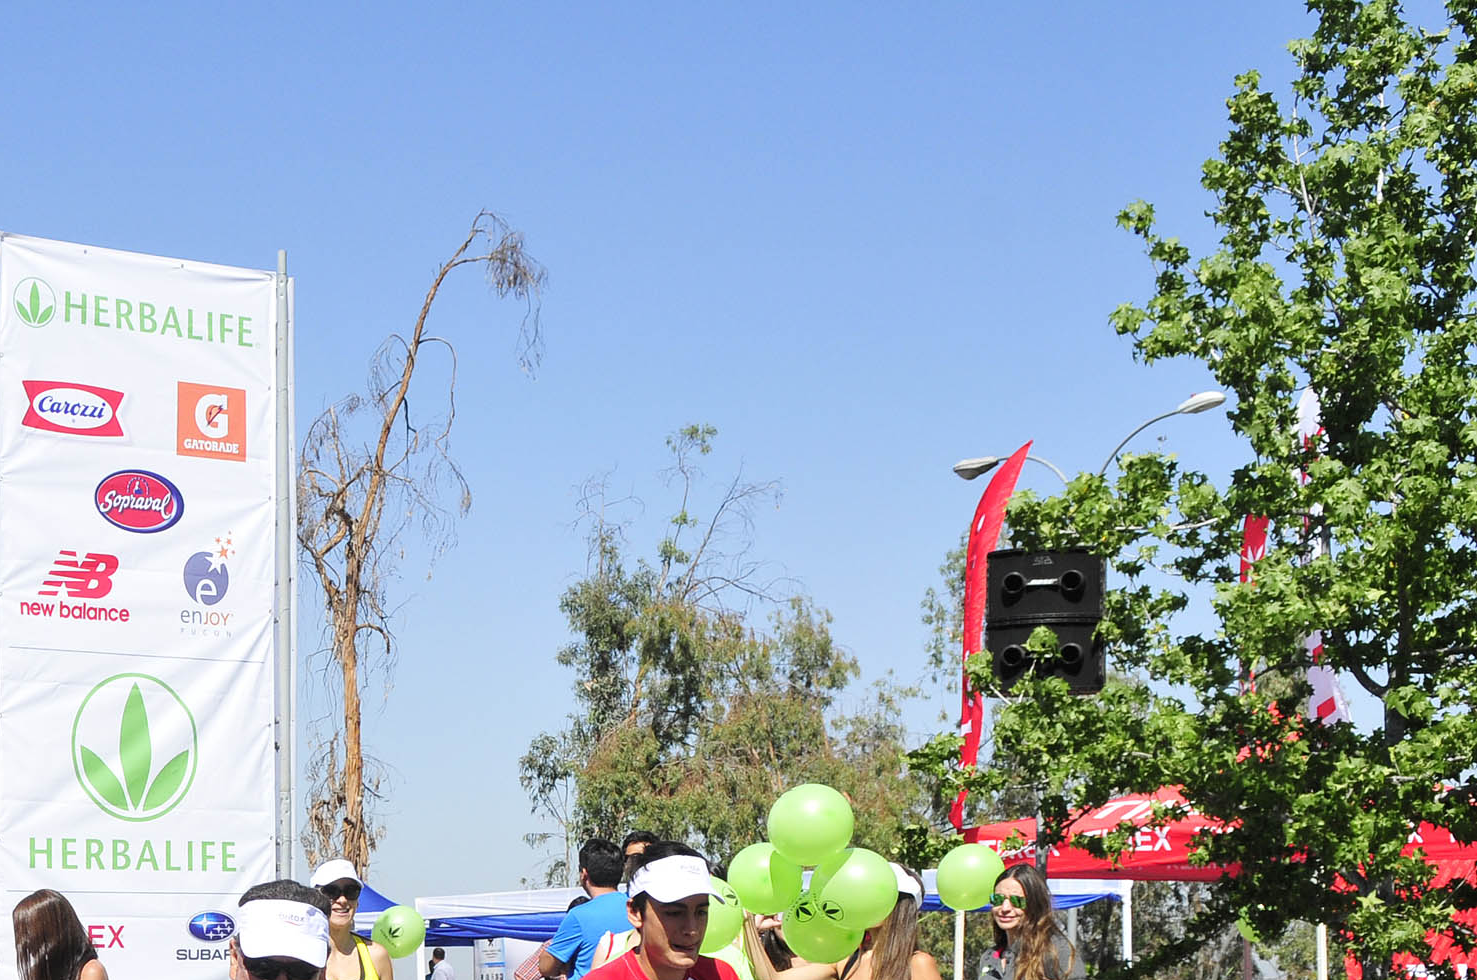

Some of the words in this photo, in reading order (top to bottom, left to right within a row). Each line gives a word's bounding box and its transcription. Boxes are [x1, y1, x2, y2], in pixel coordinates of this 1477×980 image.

[65, 290, 253, 348] HERBALIFE
[37, 394, 107, 420] Carozzi
[184, 438, 239, 454] GATORADE
[99, 490, 172, 520] Sopraval
[20, 601, 55, 618] new
[59, 602, 130, 623] balance
[29, 837, 237, 872] HERBALIFE
